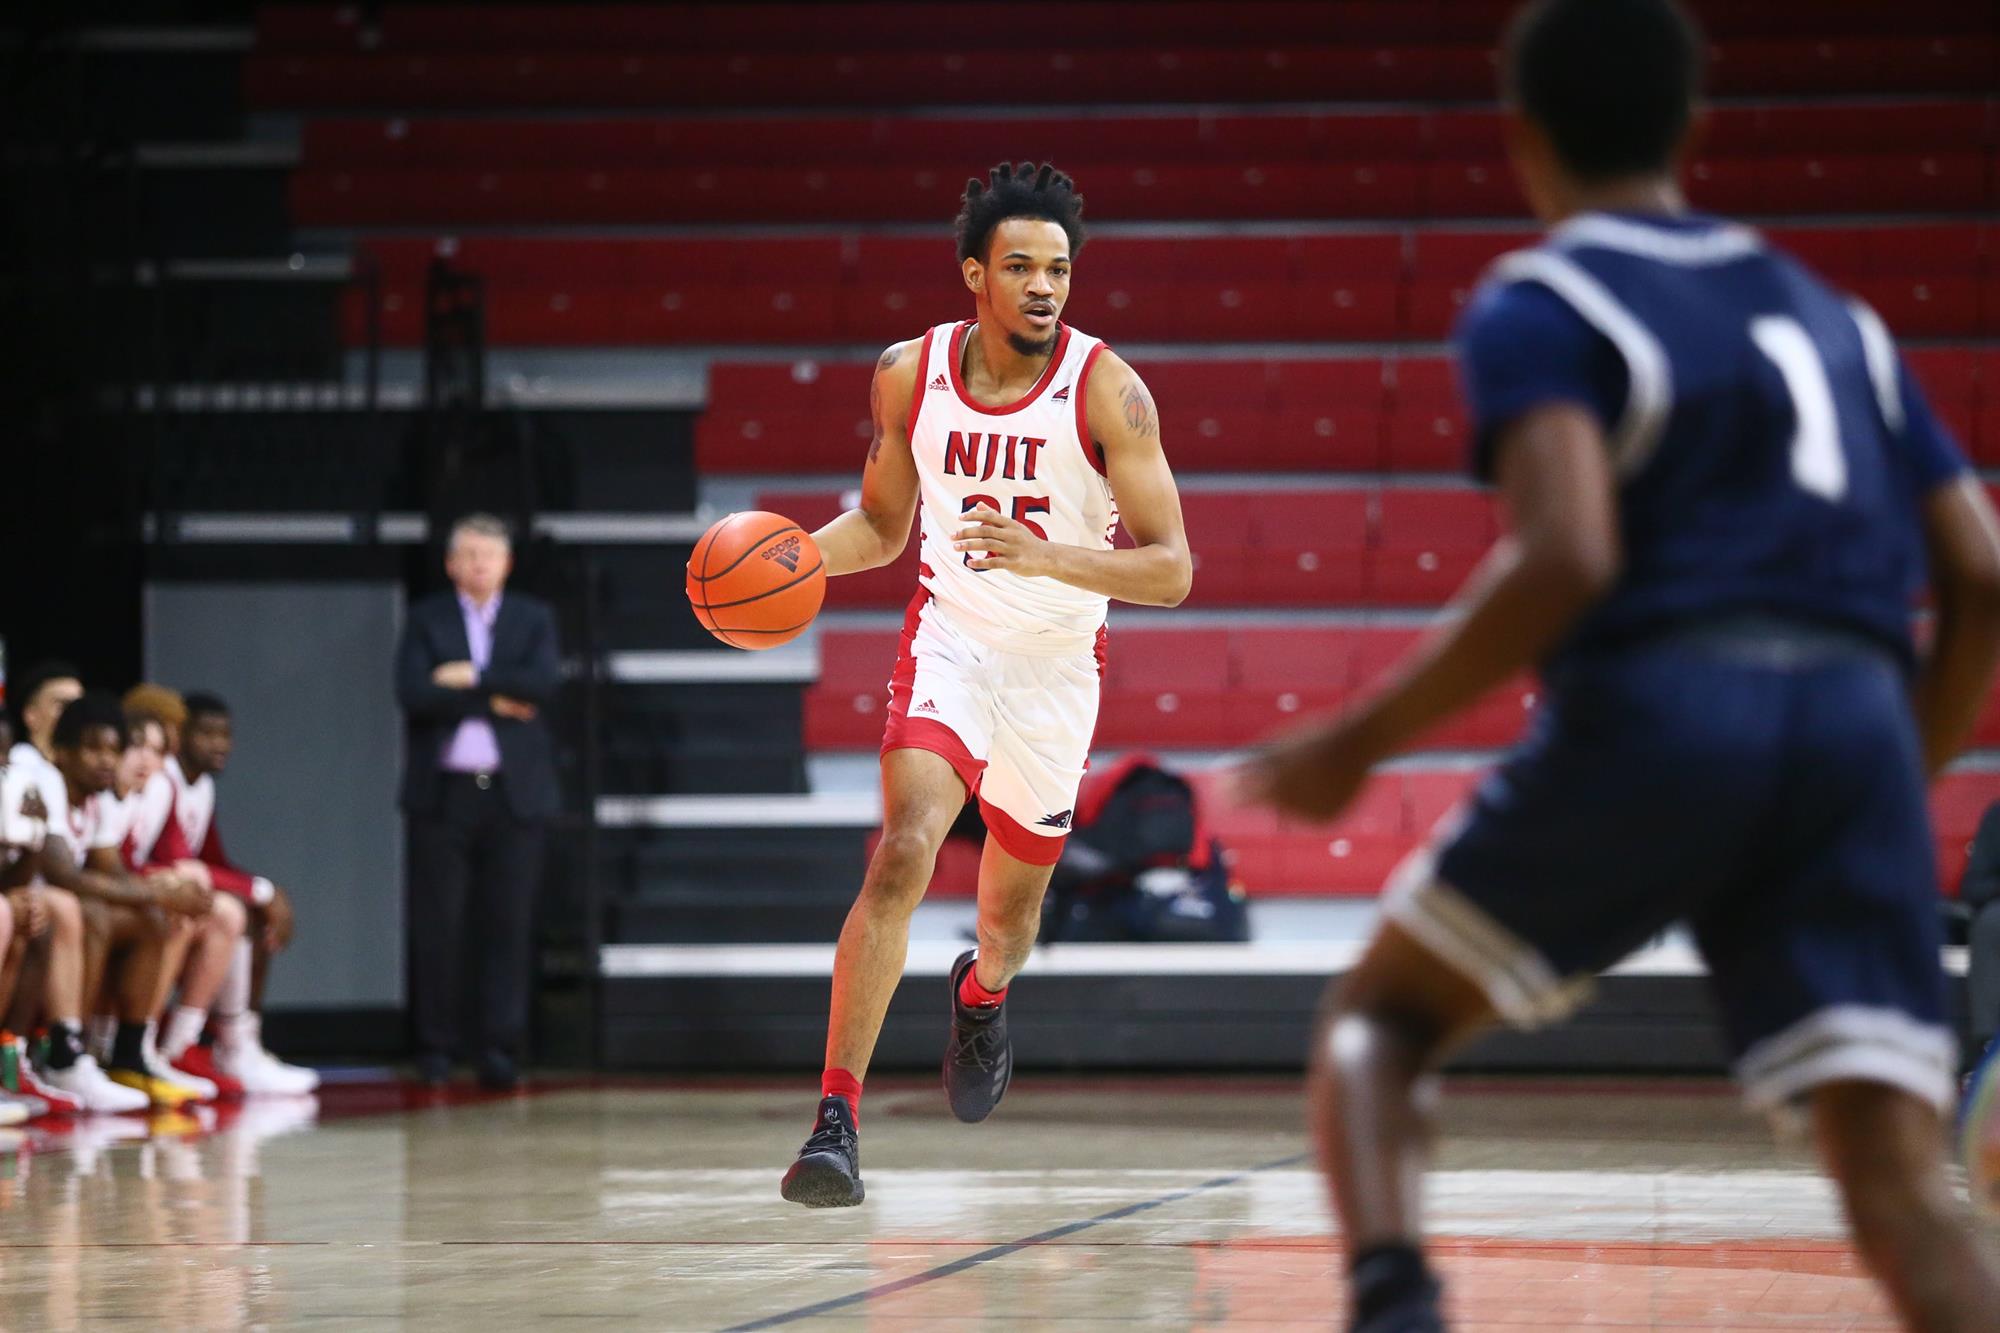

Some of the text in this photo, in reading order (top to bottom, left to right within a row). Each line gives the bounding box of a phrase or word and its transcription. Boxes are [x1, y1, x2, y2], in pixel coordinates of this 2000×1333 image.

[1748, 315, 1848, 501] 1
[944, 431, 1047, 482] NJIT
[761, 536, 799, 560] adidas
